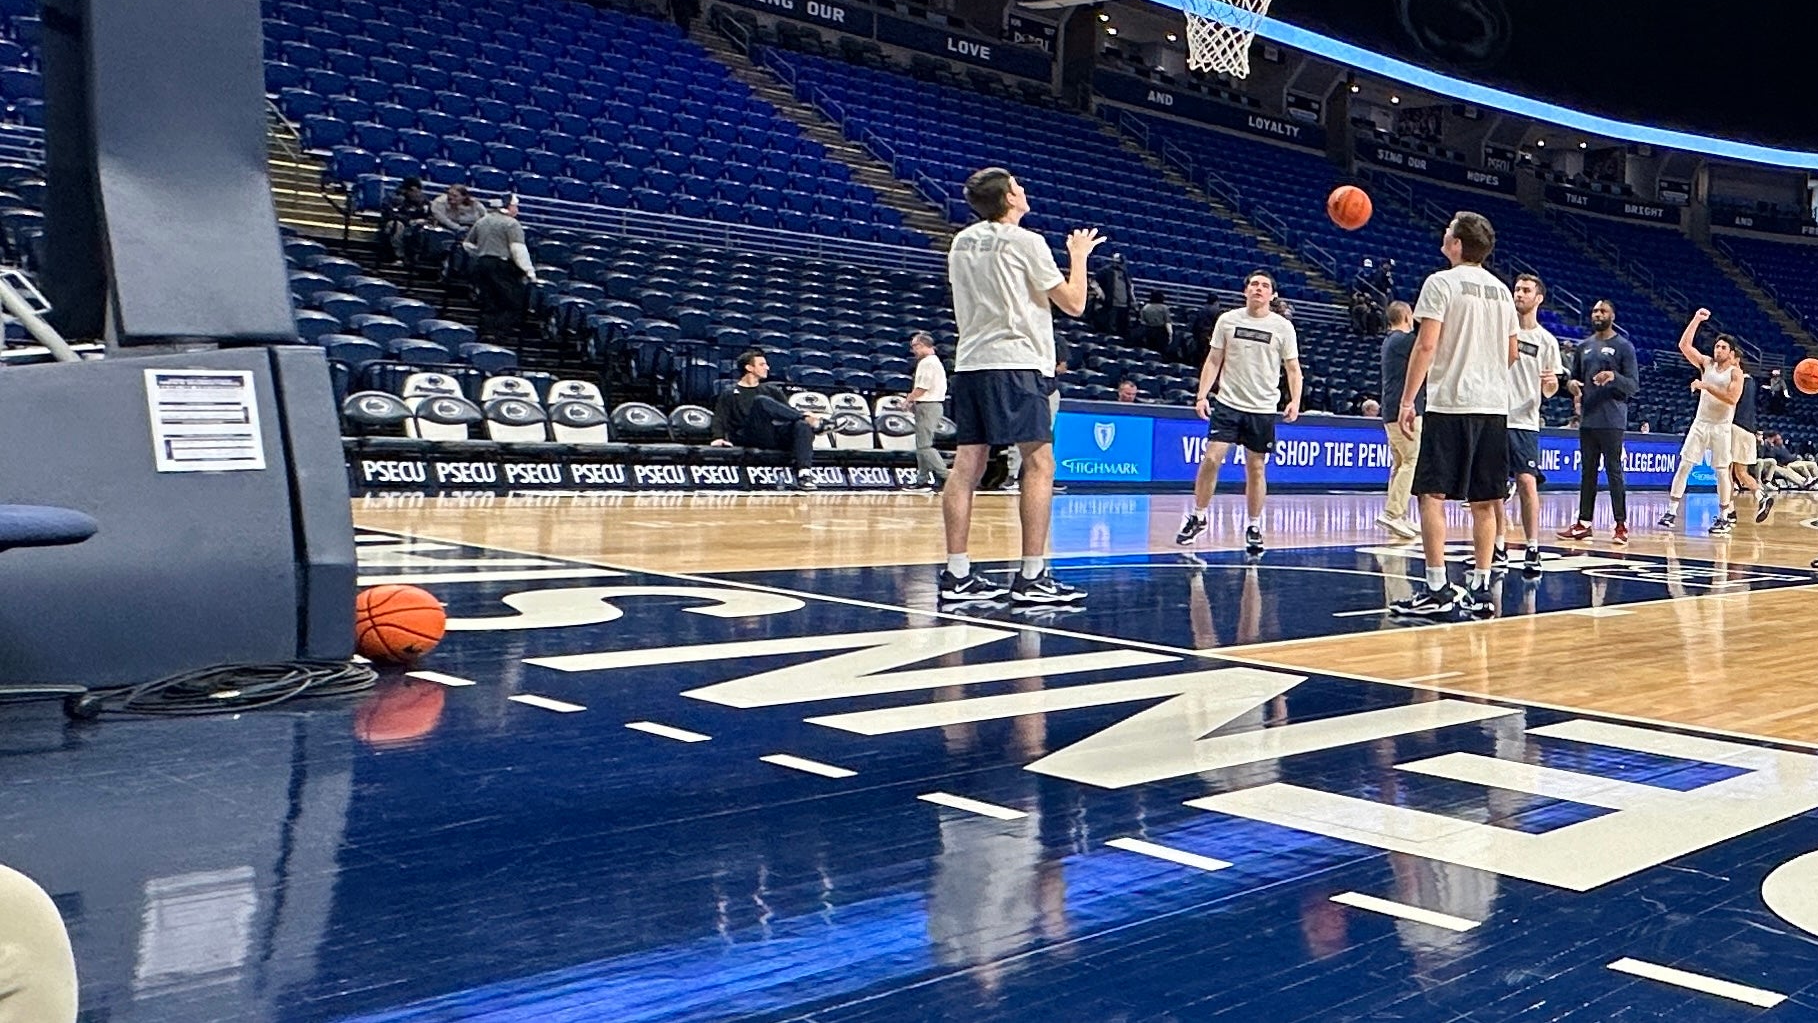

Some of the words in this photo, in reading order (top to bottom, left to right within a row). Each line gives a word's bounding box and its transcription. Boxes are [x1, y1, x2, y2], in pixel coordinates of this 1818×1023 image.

[806, 0, 846, 24] OUR
[946, 36, 992, 61] LOVE
[1146, 89, 1174, 107] AND
[1247, 115, 1301, 138] LOYALTY
[1376, 148, 1404, 165] SING
[1407, 156, 1427, 170] OUR
[1466, 170, 1500, 187] HOPES
[1565, 192, 1589, 207] THAT
[1624, 204, 1665, 218] BRIGHT
[1734, 216, 1754, 227] AND
[1275, 441, 1320, 467] SHOP
[1323, 442, 1354, 468] THE
[361, 460, 425, 483] PSECU
[436, 462, 497, 483] PSECU
[504, 463, 562, 484] PSECU
[571, 463, 626, 484] PSECU
[634, 465, 684, 485] PSECU
[690, 465, 740, 485] PSECU
[810, 466, 844, 485] SECU
[848, 466, 891, 485] PSECU
[1061, 458, 1139, 476] HIGHMARK
